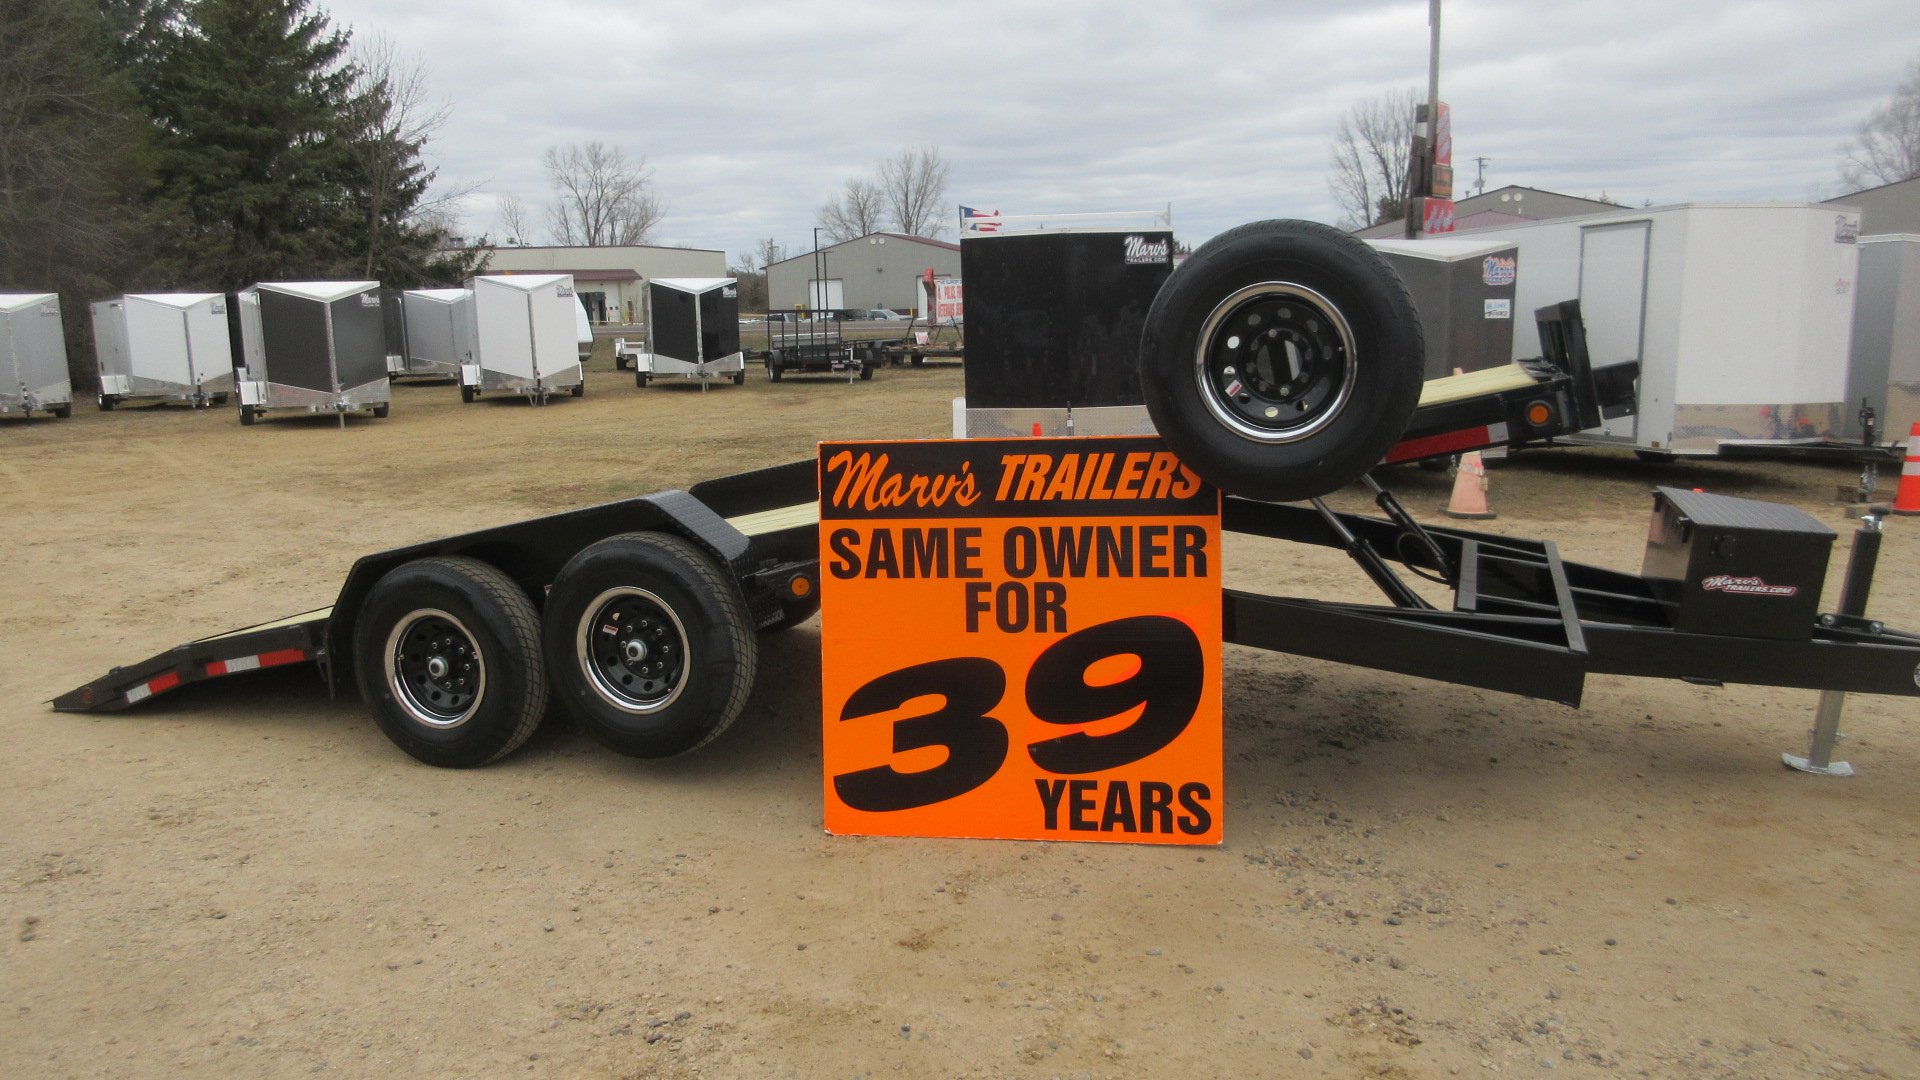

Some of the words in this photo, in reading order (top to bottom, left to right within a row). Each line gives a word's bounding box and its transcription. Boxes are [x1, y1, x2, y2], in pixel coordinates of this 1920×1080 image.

[1124, 235, 1168, 257] Marv's
[827, 450, 981, 511] Marv's
[995, 452, 1201, 501] TRAILERS
[829, 527, 983, 579] SAME
[1003, 525, 1208, 578] OWNER
[965, 581, 1067, 633] FOR
[1705, 577, 1759, 588] Marv's
[1726, 585, 1792, 594] TRAILERS.COM
[833, 615, 1204, 812] 39
[1035, 779, 1212, 835] YEARS
